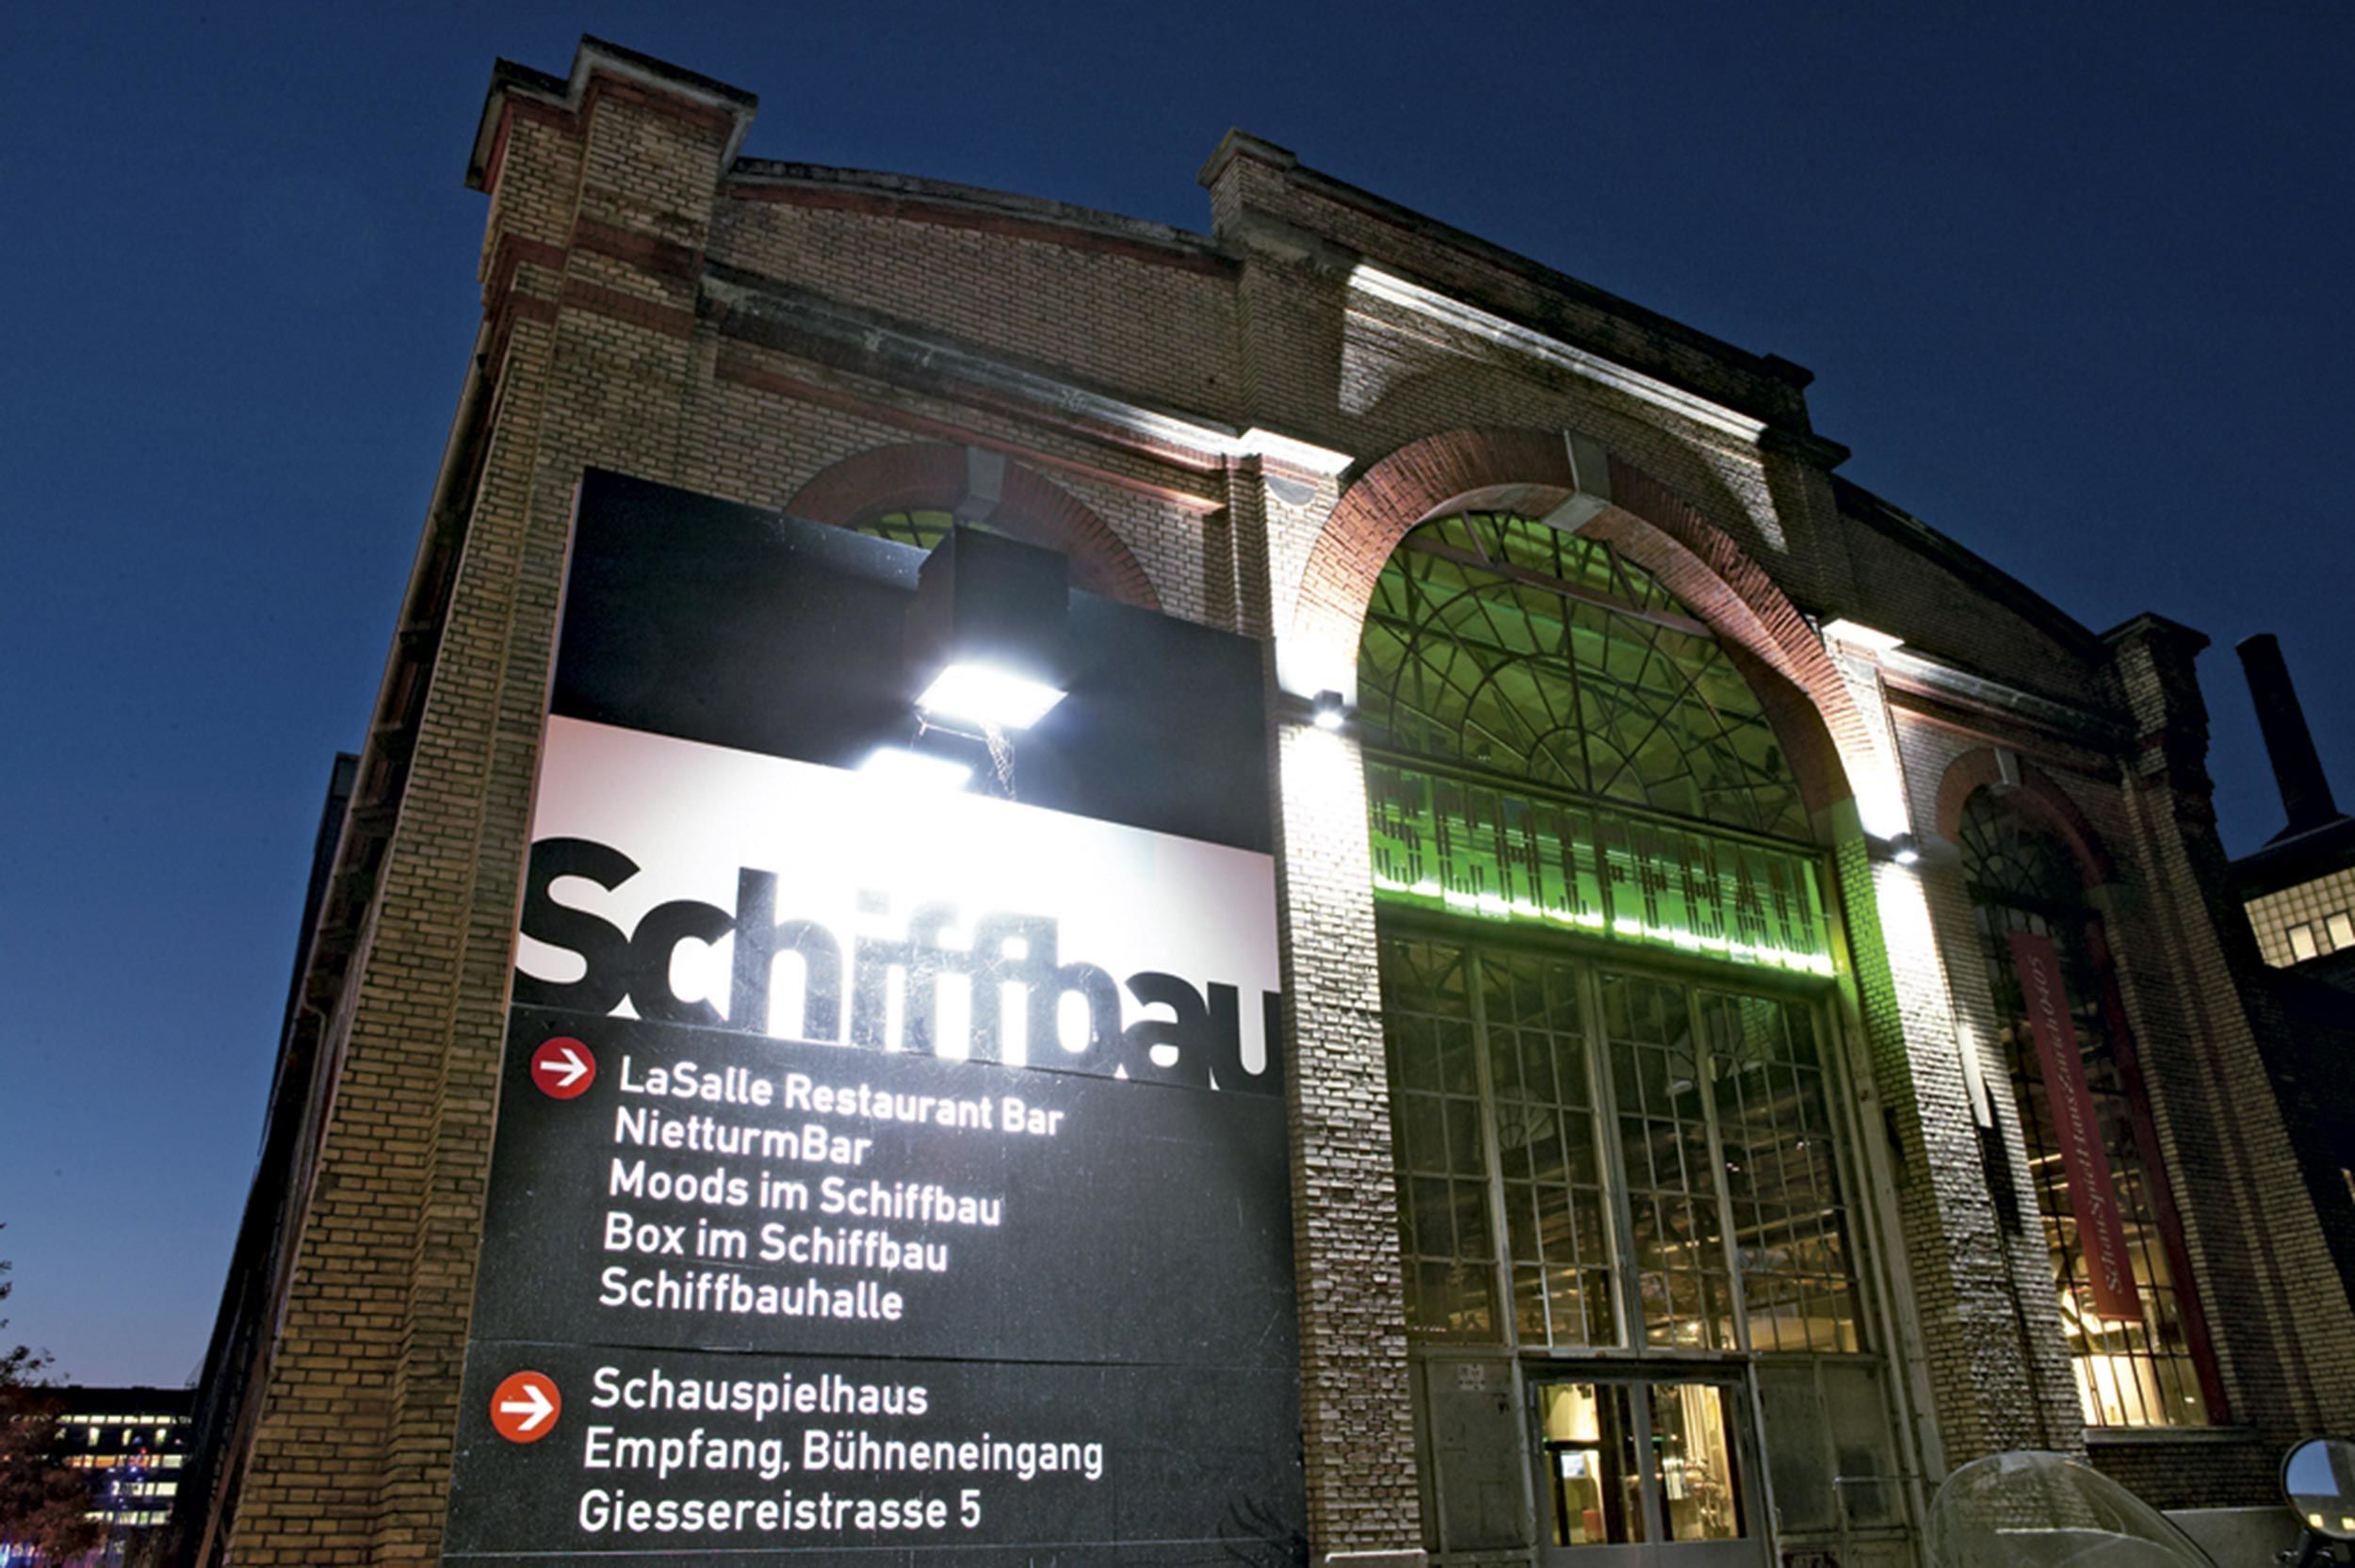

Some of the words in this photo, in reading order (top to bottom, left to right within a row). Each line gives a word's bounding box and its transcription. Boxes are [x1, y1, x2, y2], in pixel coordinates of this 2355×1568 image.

[619, 1055, 773, 1107] LaSalle
[785, 1073, 993, 1130] Restaurant
[1001, 1097, 1065, 1137] Bar
[614, 1105, 872, 1166] NietturmBar
[609, 1157, 749, 1207] Moods
[759, 1169, 808, 1212] im
[820, 1175, 1002, 1228] Schiffbau
[603, 1210, 687, 1256] Box
[696, 1217, 747, 1260] im
[757, 1222, 949, 1273] Schiffbau
[598, 1266, 904, 1322] Schiffbauhalle
[590, 1366, 929, 1423] Schauspielhaus
[583, 1425, 791, 1481] Empfang,
[803, 1428, 1104, 1482] Bühneneingang
[578, 1488, 949, 1533] Giessereistrasse
[960, 1488, 982, 1530] 5
